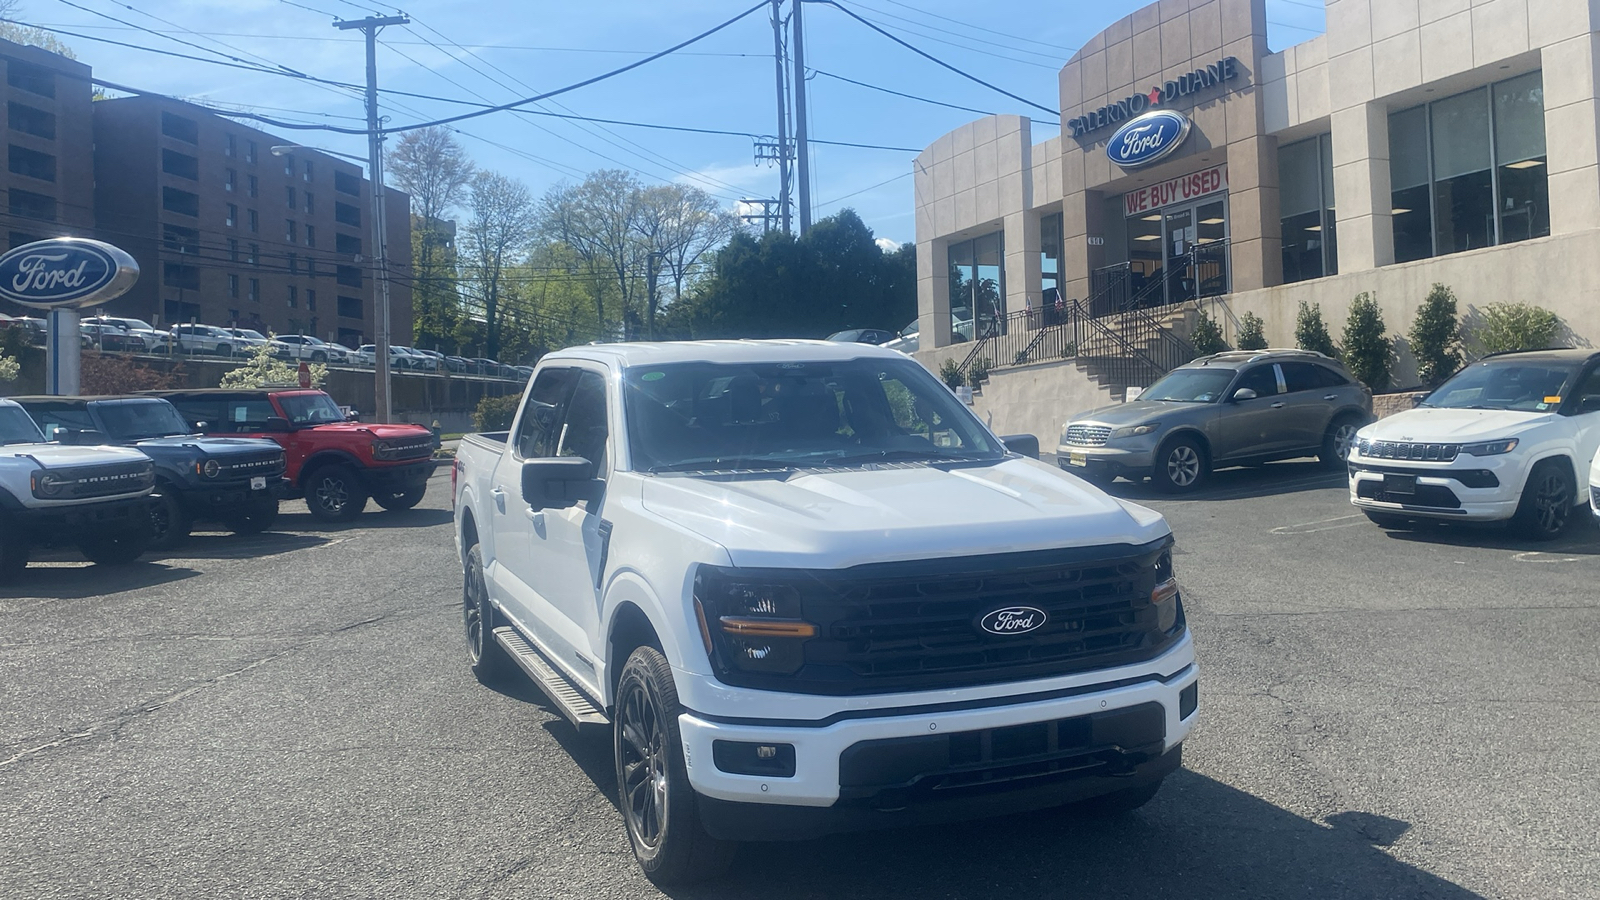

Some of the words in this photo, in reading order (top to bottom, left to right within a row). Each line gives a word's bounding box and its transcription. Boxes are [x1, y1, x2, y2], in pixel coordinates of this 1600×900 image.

[1067, 93, 1147, 137] SALERNO
[1163, 56, 1237, 102] DUANE
[1120, 124, 1164, 159] Ford
[1126, 190, 1147, 213] WE
[1151, 180, 1178, 207] BUY
[1182, 168, 1221, 198] USED
[12, 253, 88, 292] Ford
[78, 473, 137, 484] BRONCO
[232, 460, 275, 469] BRONCO
[994, 610, 1034, 631] Ford
